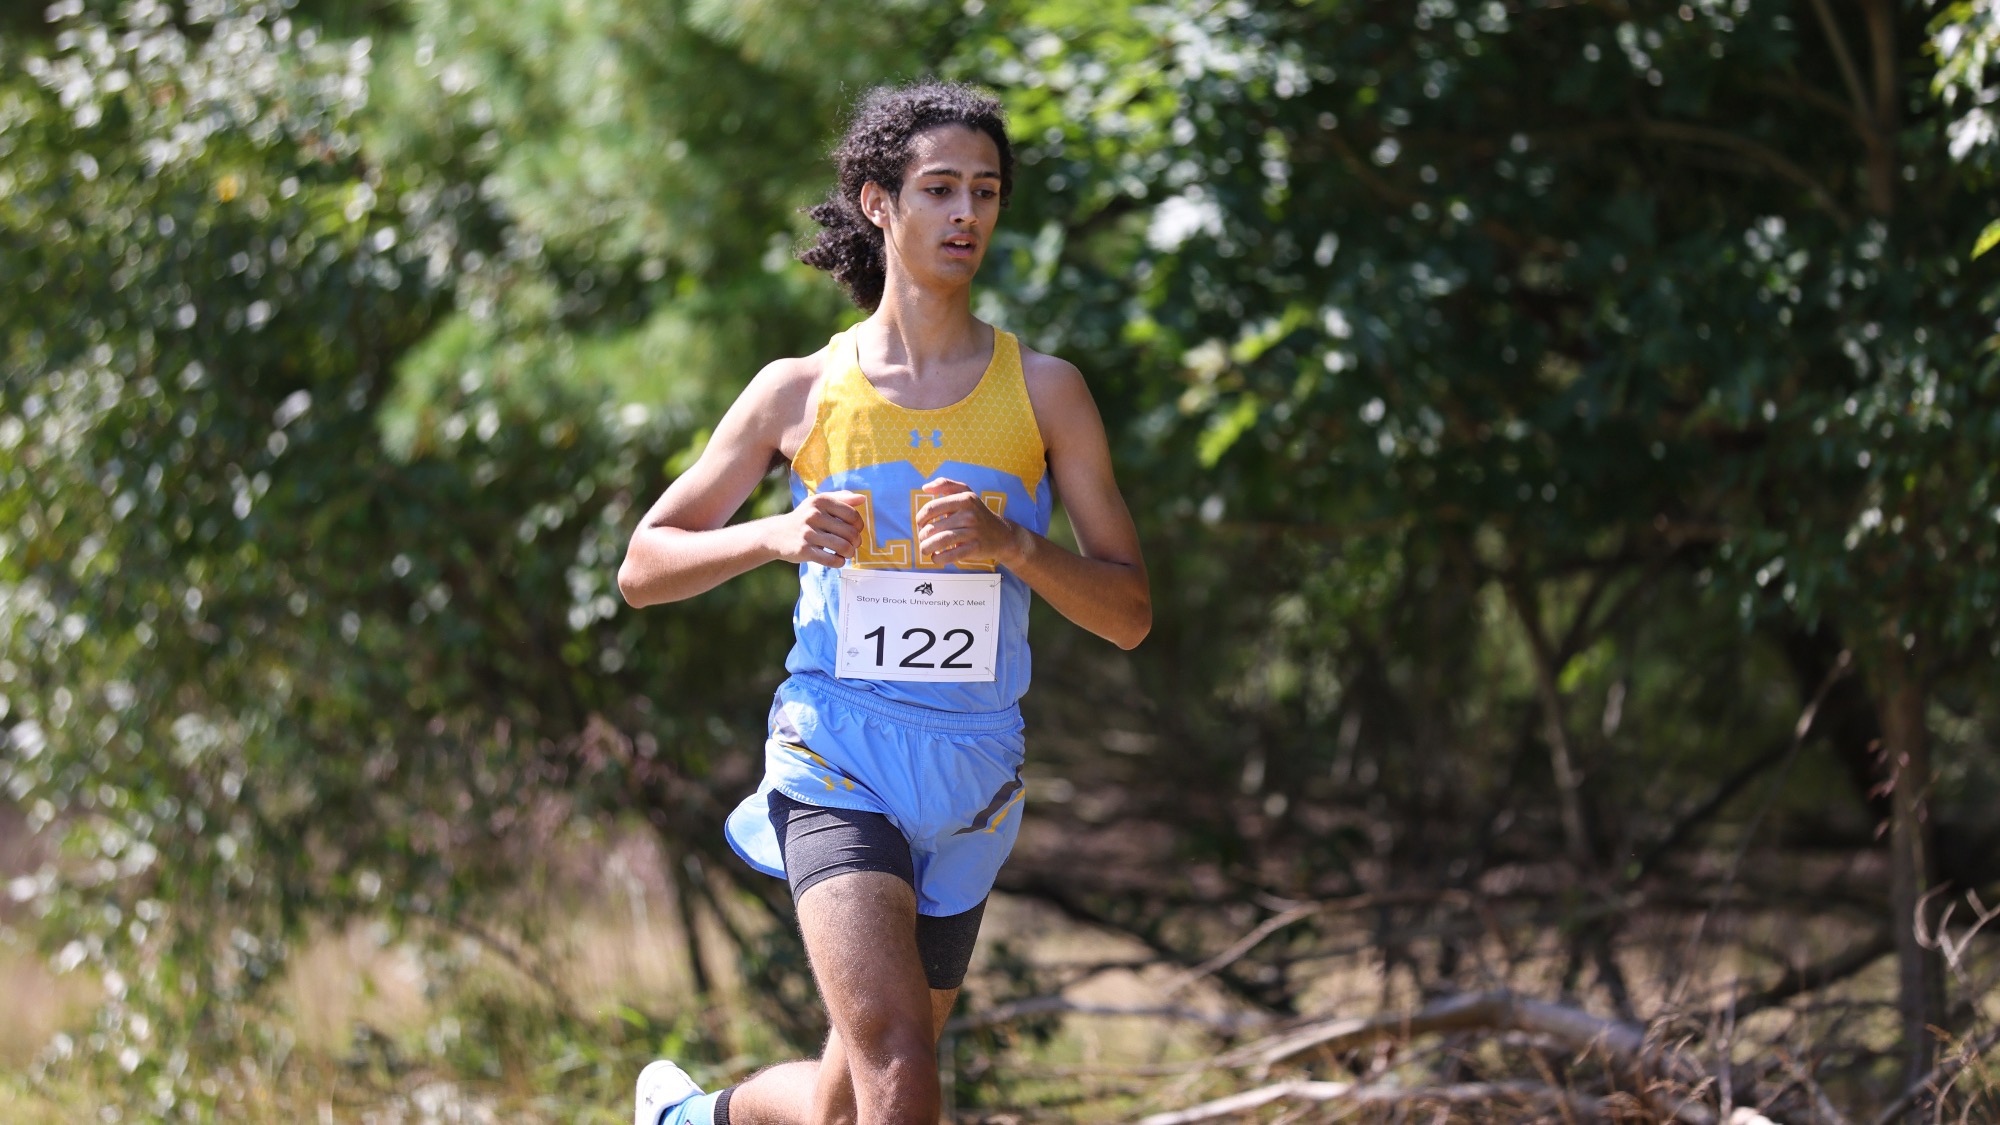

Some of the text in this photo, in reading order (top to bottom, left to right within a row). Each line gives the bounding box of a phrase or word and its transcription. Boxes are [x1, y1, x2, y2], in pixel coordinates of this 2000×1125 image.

[856, 595, 880, 603] Stony
[882, 596, 908, 604] Brook
[910, 598, 951, 607] University
[864, 625, 975, 669] 122
